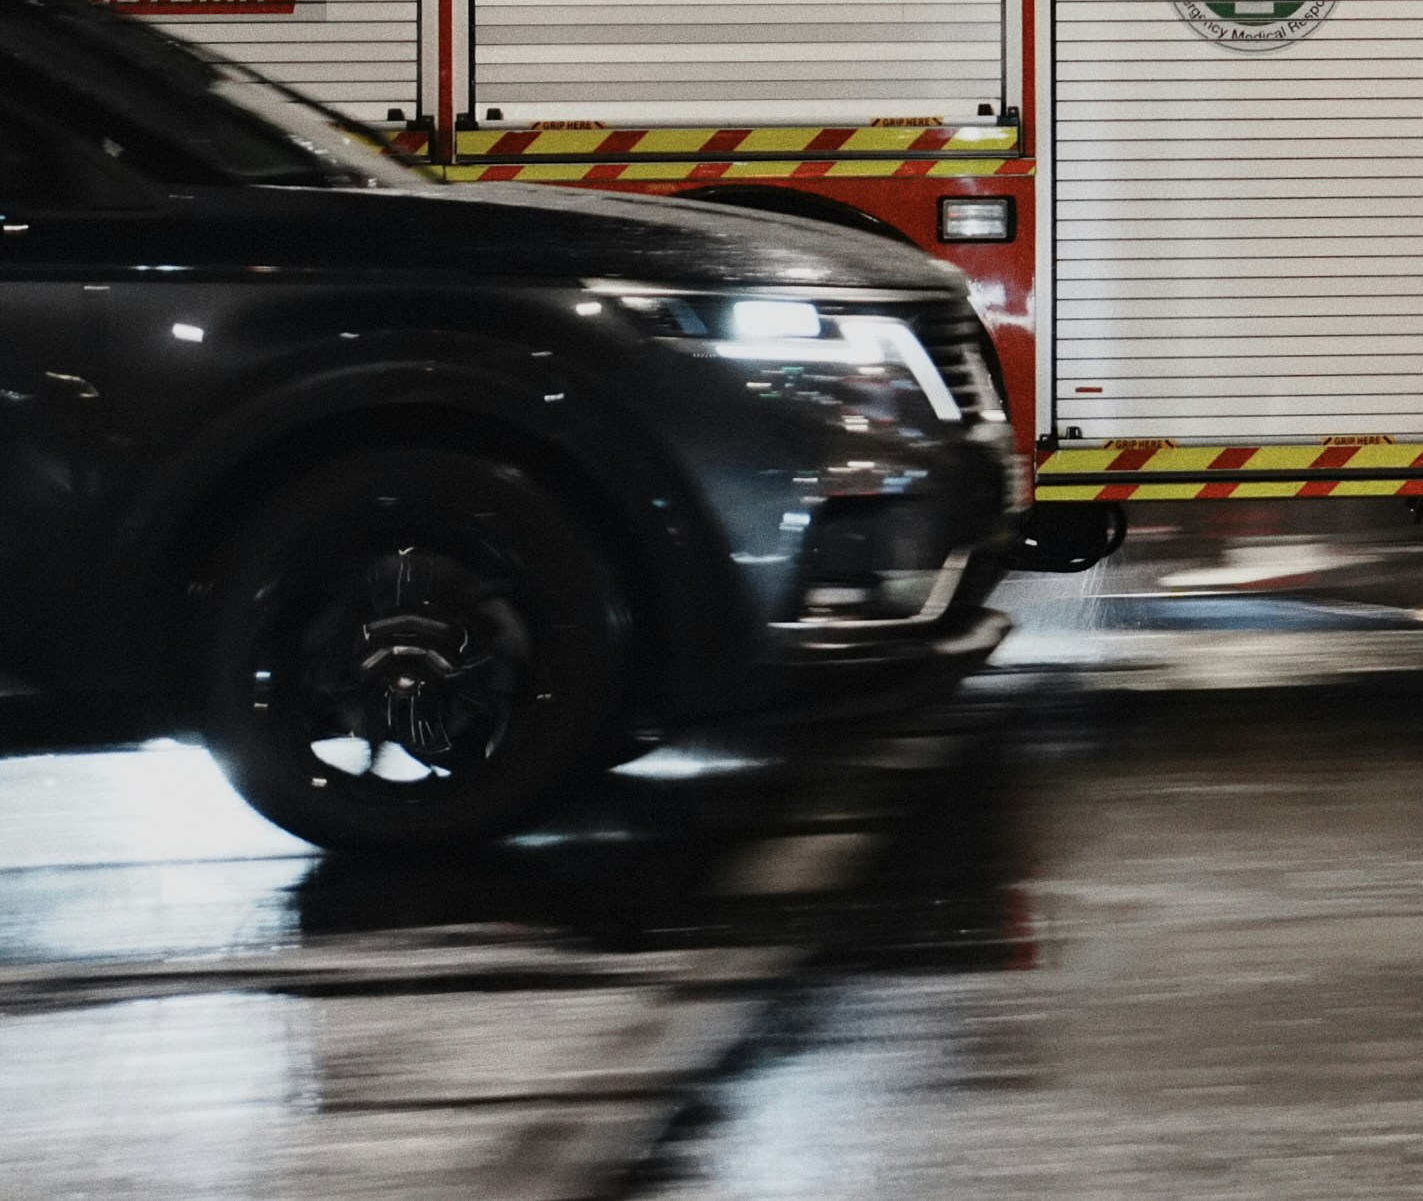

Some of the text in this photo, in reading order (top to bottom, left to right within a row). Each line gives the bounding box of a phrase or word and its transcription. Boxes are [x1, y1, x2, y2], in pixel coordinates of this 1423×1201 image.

[1231, 27, 1287, 40] Medical
[543, 120, 593, 130] GRIP HERE
[882, 117, 930, 127] GRIP HERE
[1115, 440, 1162, 449] GRIP HERE
[1333, 436, 1380, 445] GRIP HERE
